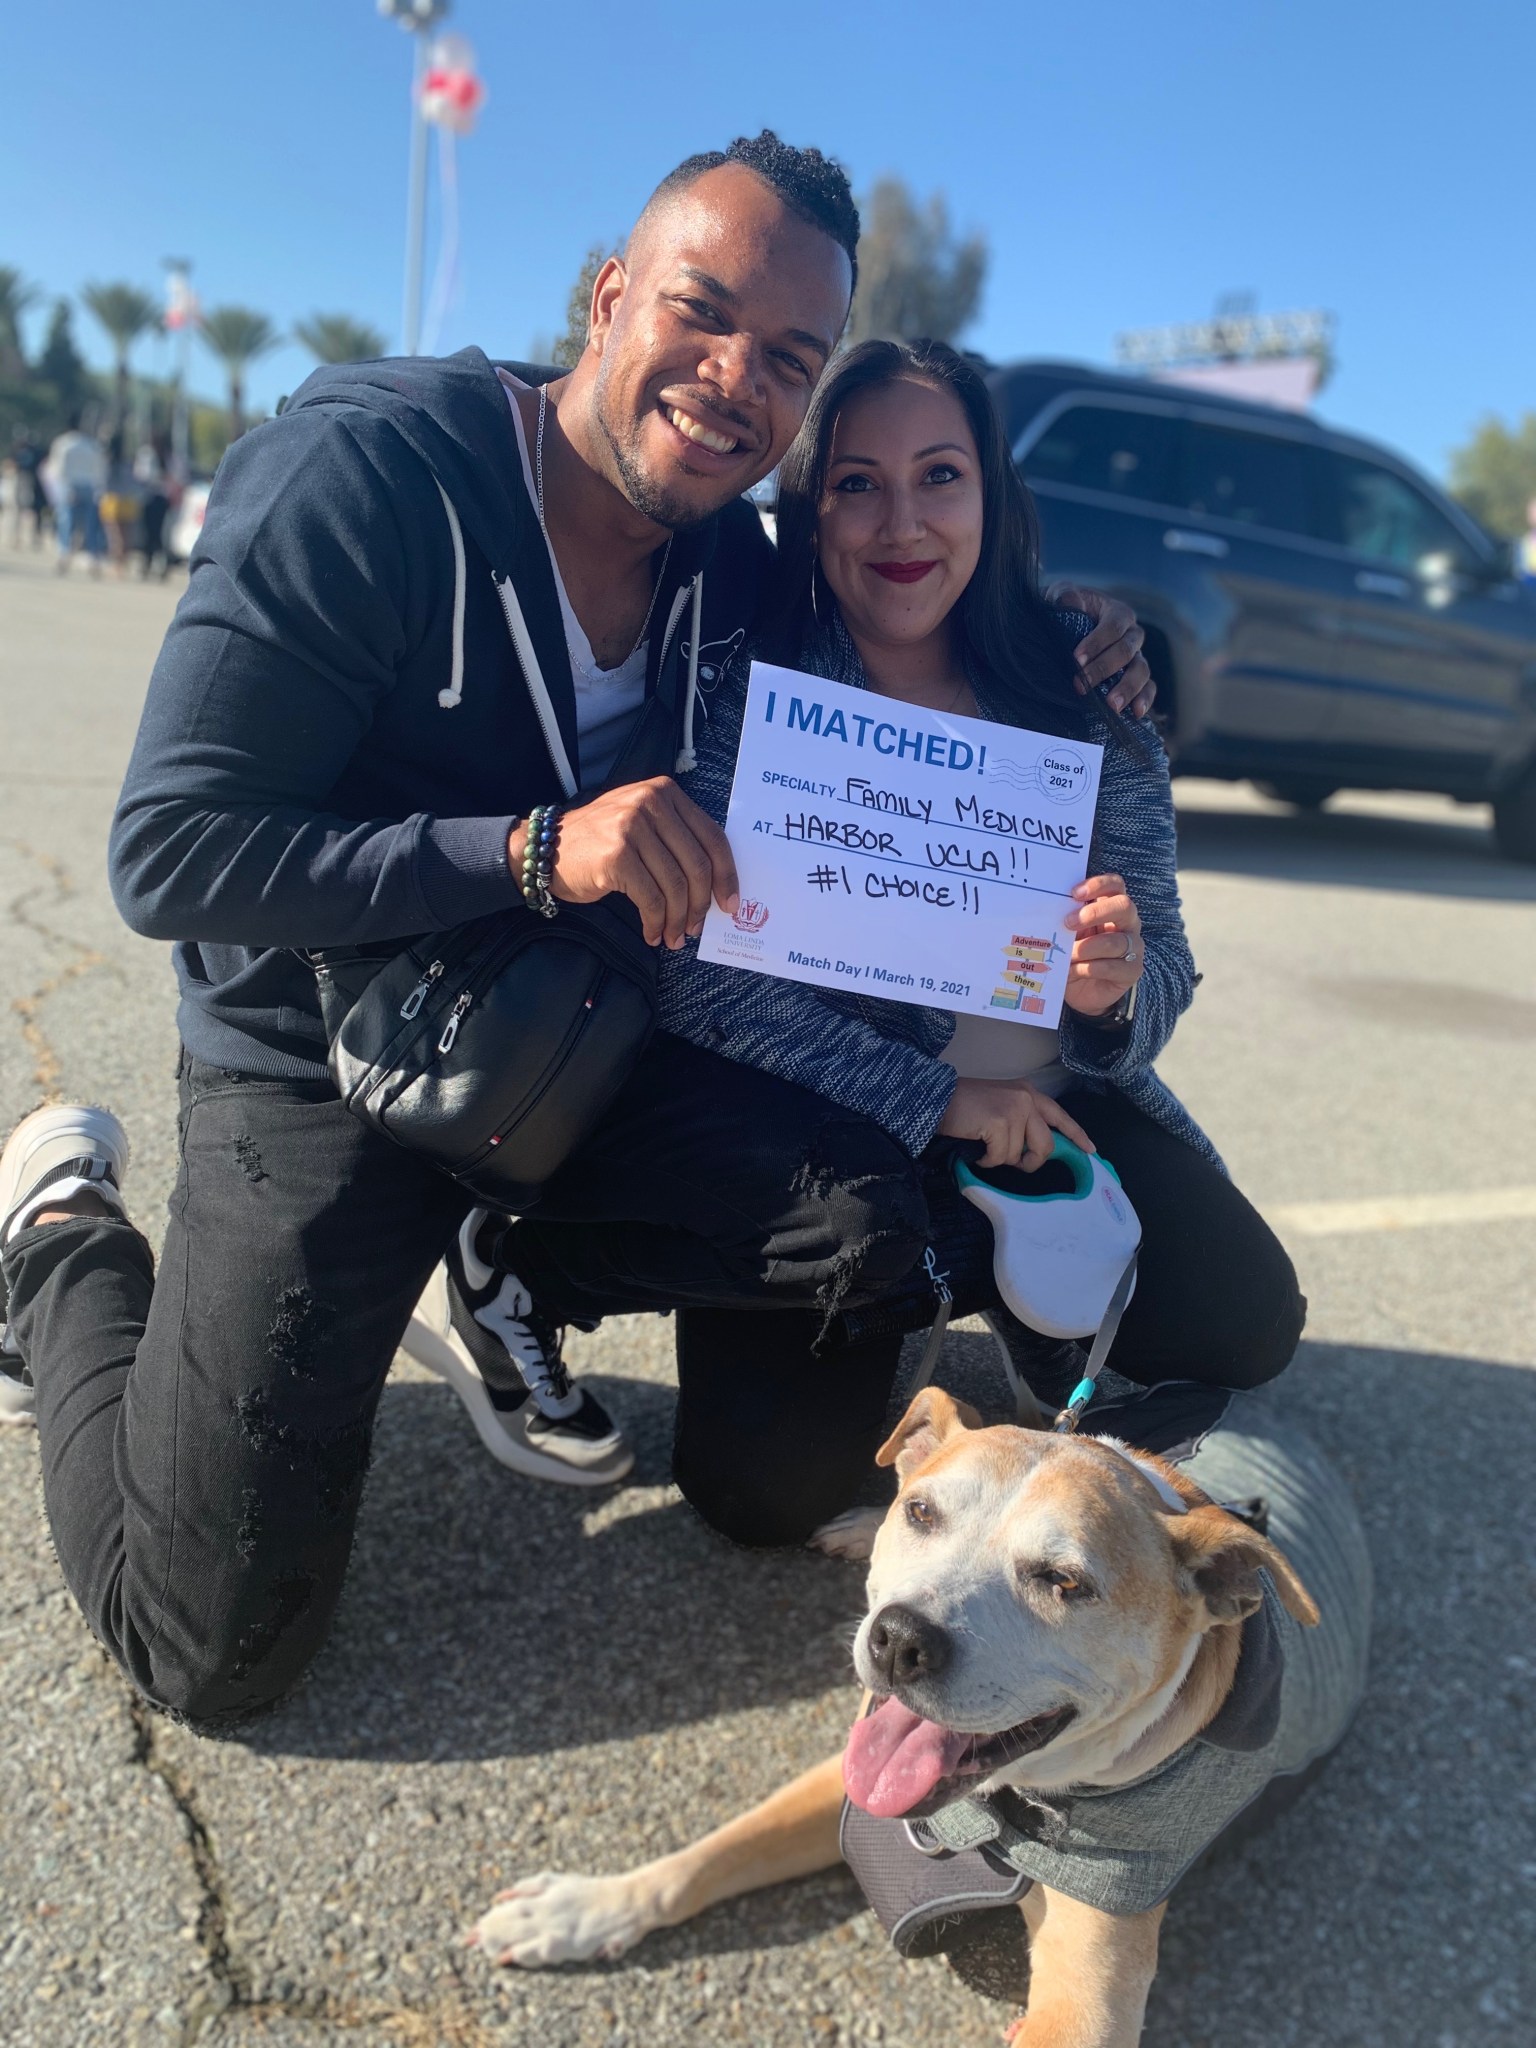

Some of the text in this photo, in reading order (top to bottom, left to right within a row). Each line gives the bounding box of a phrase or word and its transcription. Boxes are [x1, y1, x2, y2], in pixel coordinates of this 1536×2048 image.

[765, 691, 987, 775] I MATCHED!
[1044, 758, 1085, 775] Class of
[1049, 775, 1073, 789] 2021
[761, 770, 836, 798] SPECIALTY
[955, 794, 1083, 849] MEDICINE
[752, 820, 774, 834] AT
[785, 813, 902, 857] HARBOR
[807, 864, 852, 895] #1
[1014, 937, 1052, 948] Adventure
[1015, 947, 1023, 957] is
[787, 950, 832, 971] Match
[835, 960, 862, 979] Day
[873, 967, 915, 986] March
[920, 977, 937, 992] 19,
[940, 980, 971, 997] 2021
[1020, 962, 1035, 971] out
[1014, 974, 1035, 988] there
